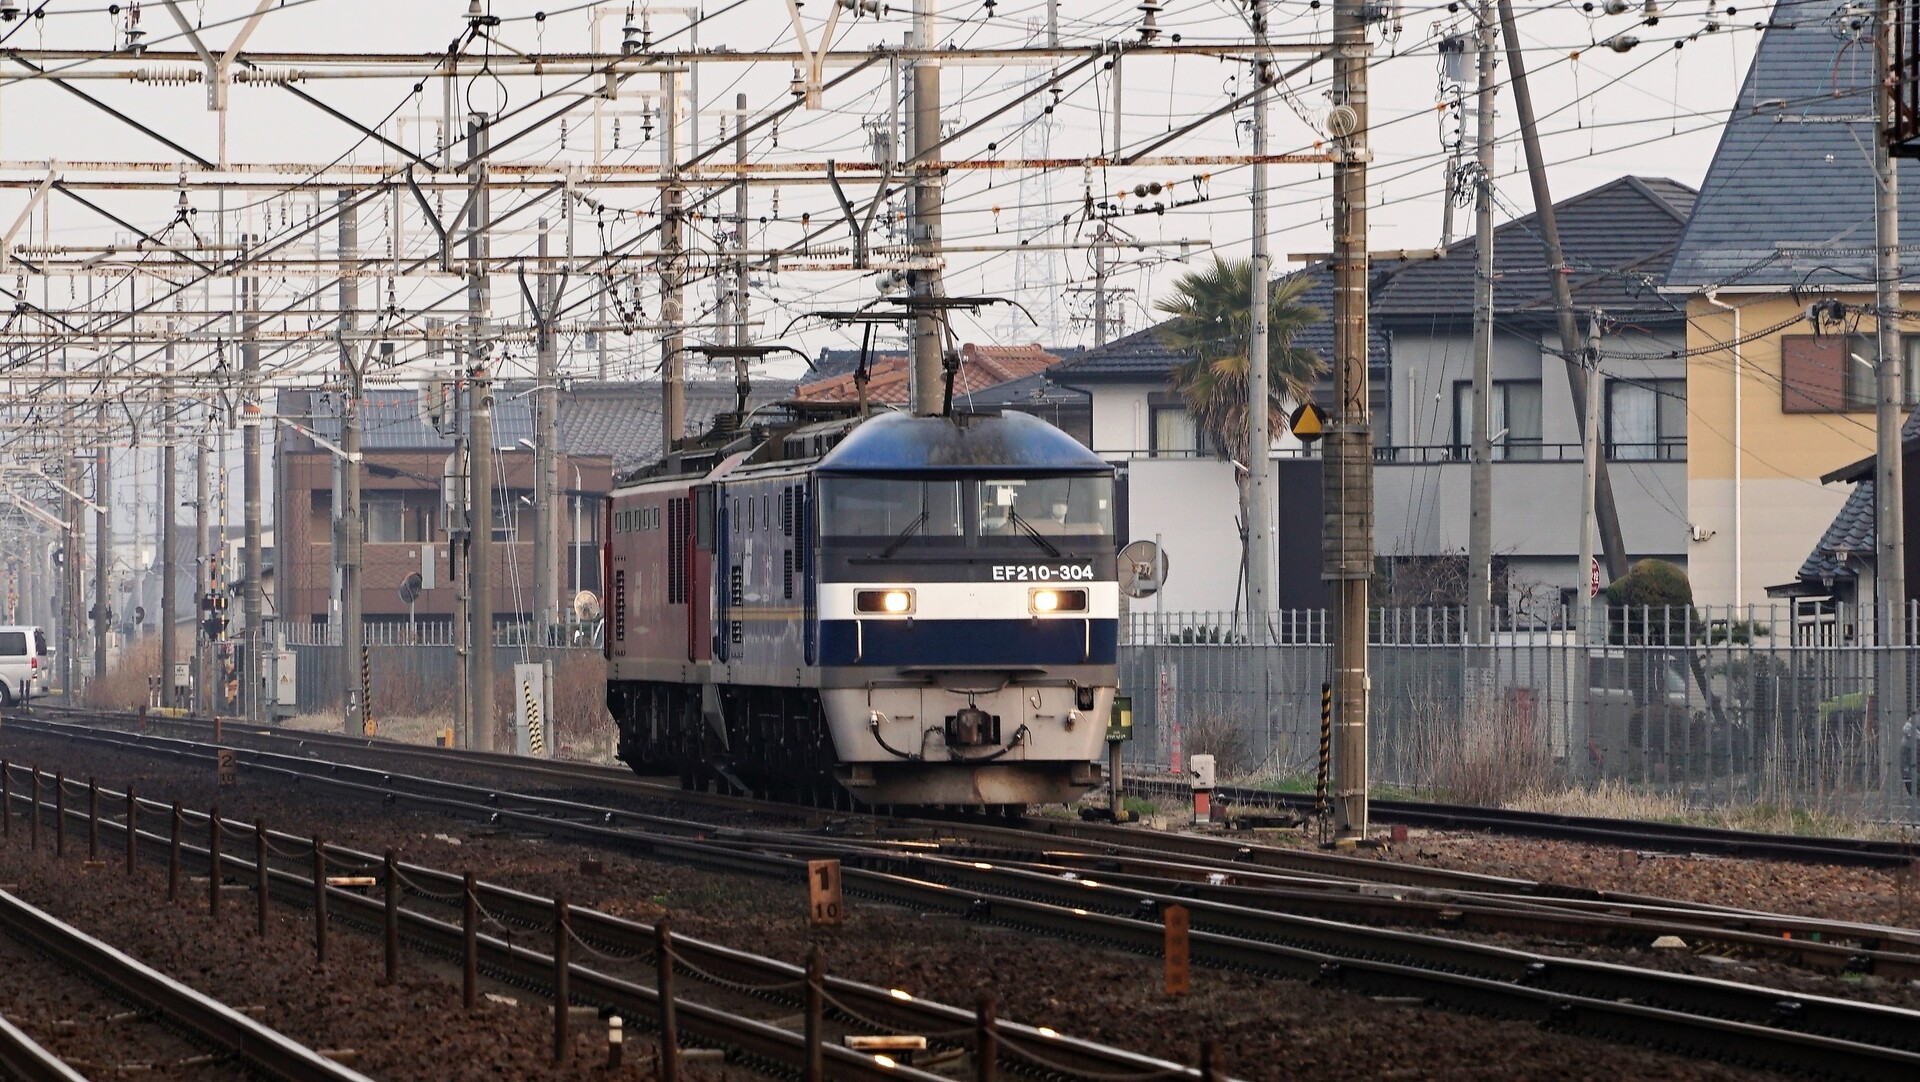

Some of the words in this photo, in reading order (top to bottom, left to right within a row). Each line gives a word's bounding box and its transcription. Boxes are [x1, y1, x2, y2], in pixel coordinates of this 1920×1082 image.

[992, 565, 1094, 580] EF210-304
[221, 755, 233, 767] 2
[815, 866, 829, 890] 1
[816, 903, 837, 918] 10
